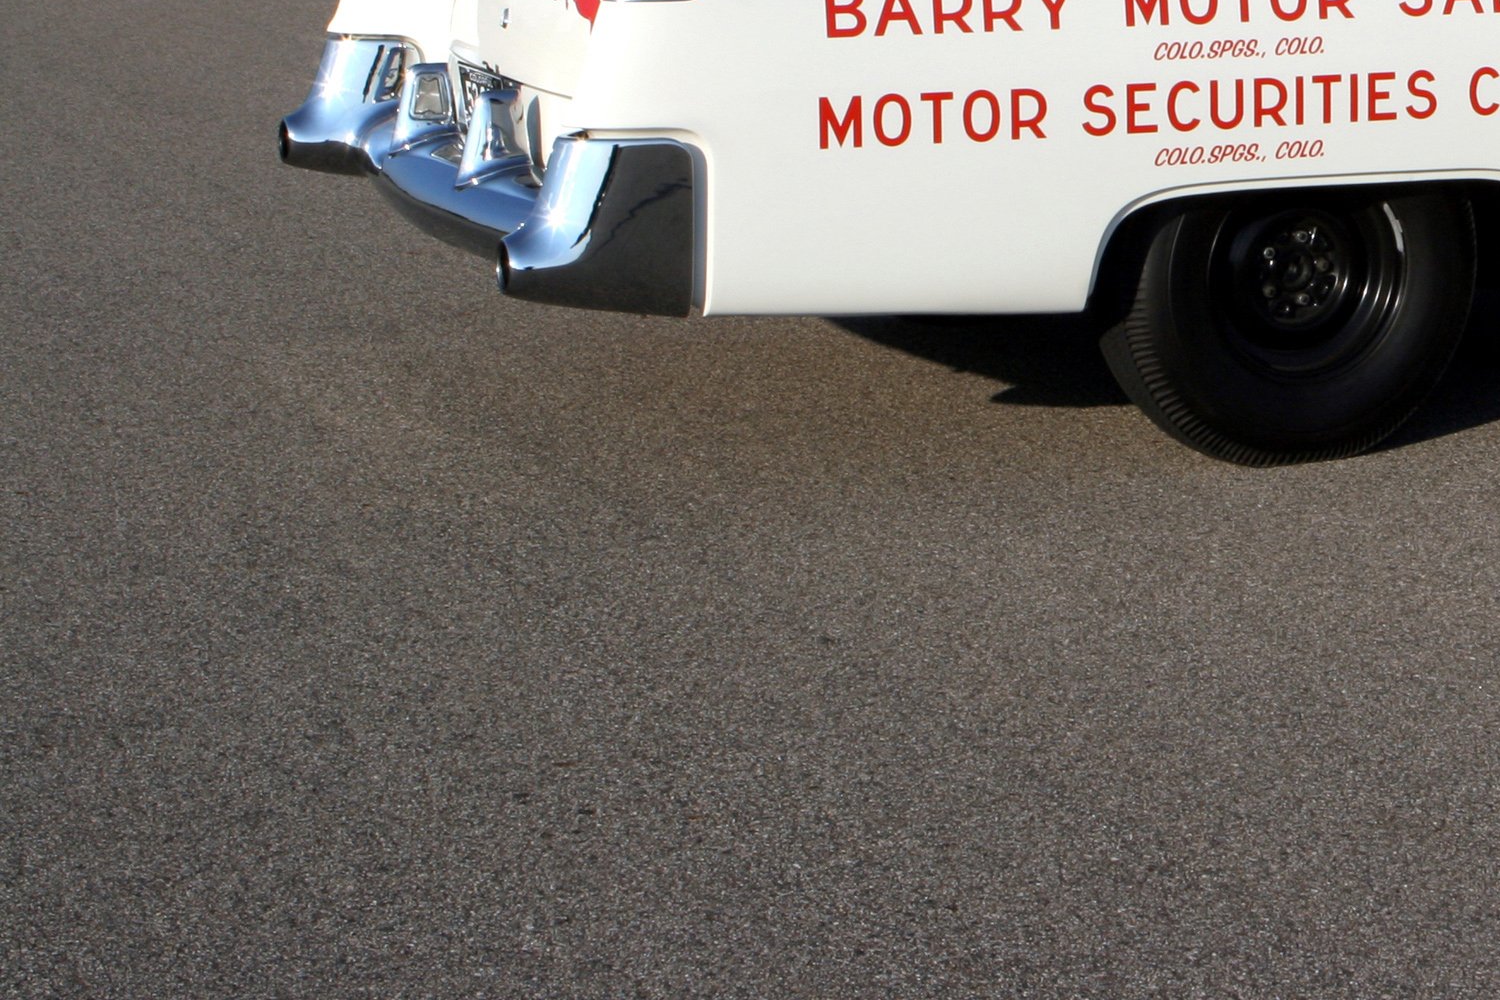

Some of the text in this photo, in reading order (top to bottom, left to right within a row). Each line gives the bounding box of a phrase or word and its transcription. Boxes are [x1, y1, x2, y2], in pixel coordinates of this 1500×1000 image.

[1274, 36, 1325, 57] COLO.
[819, 88, 1048, 150] MOTOR
[1081, 70, 1437, 138] SECURITIES
[1275, 139, 1325, 160] COLO.
